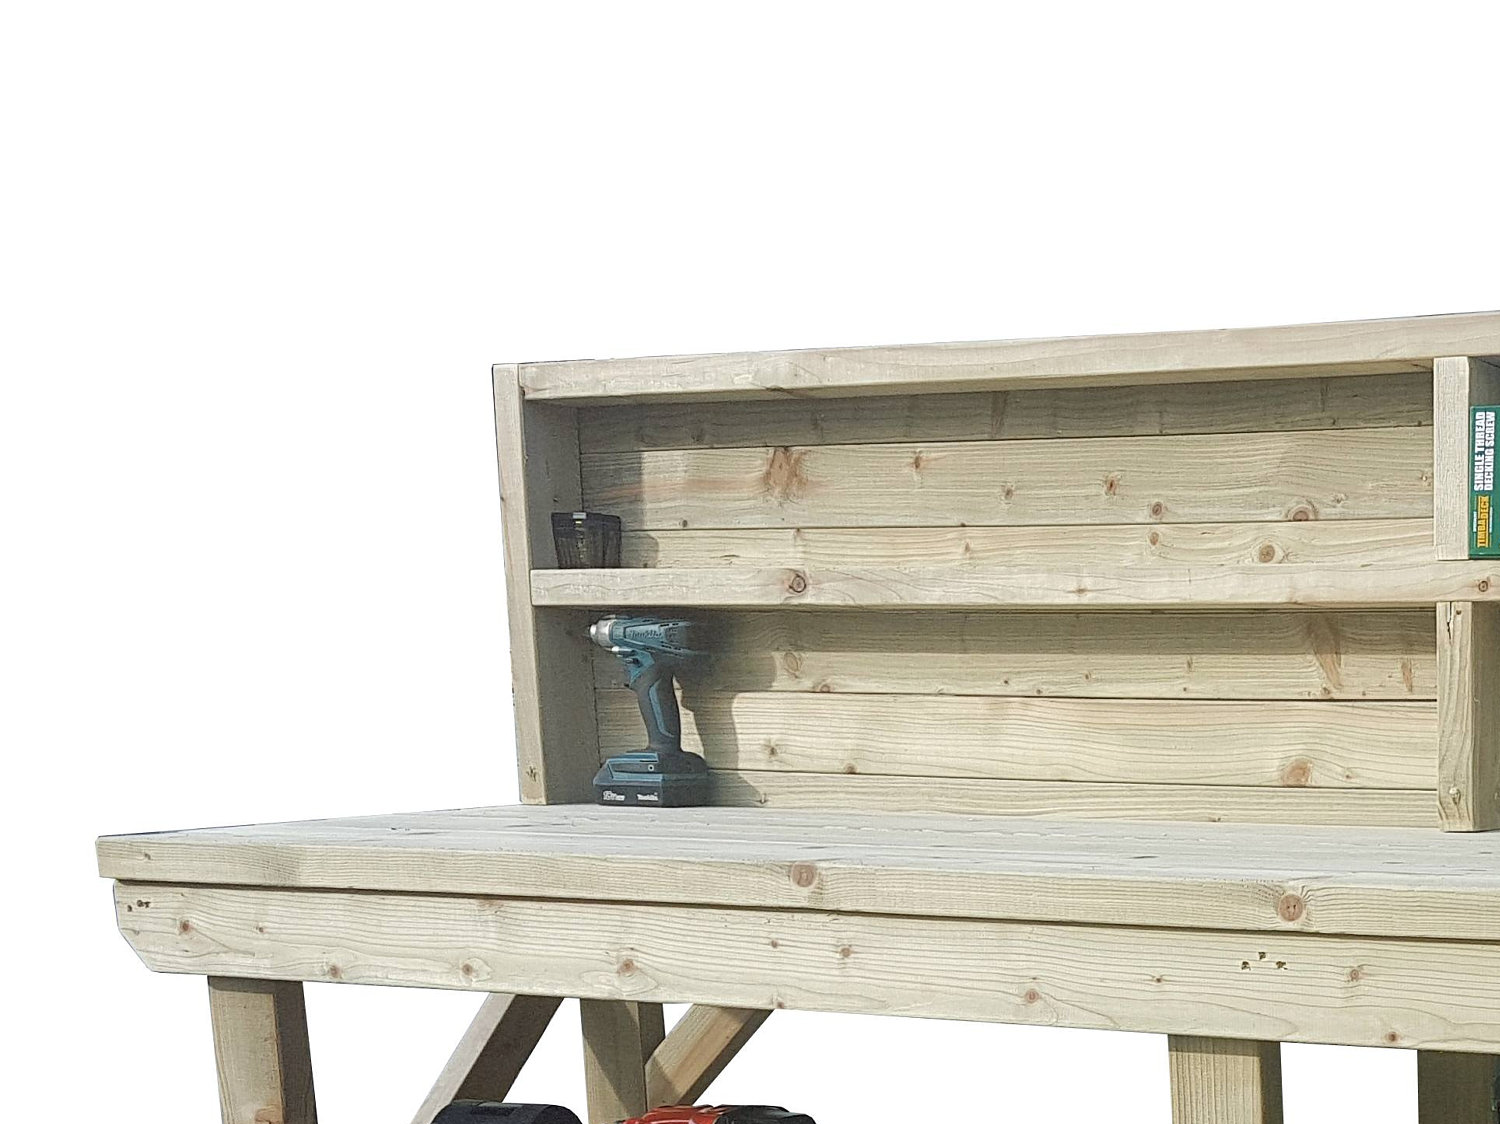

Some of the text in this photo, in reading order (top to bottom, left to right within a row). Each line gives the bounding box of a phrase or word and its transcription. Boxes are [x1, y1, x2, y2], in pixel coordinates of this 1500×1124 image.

[1474, 411, 1486, 491] SINGLE THREAD
[1484, 411, 1495, 491] DECKING SCREW
